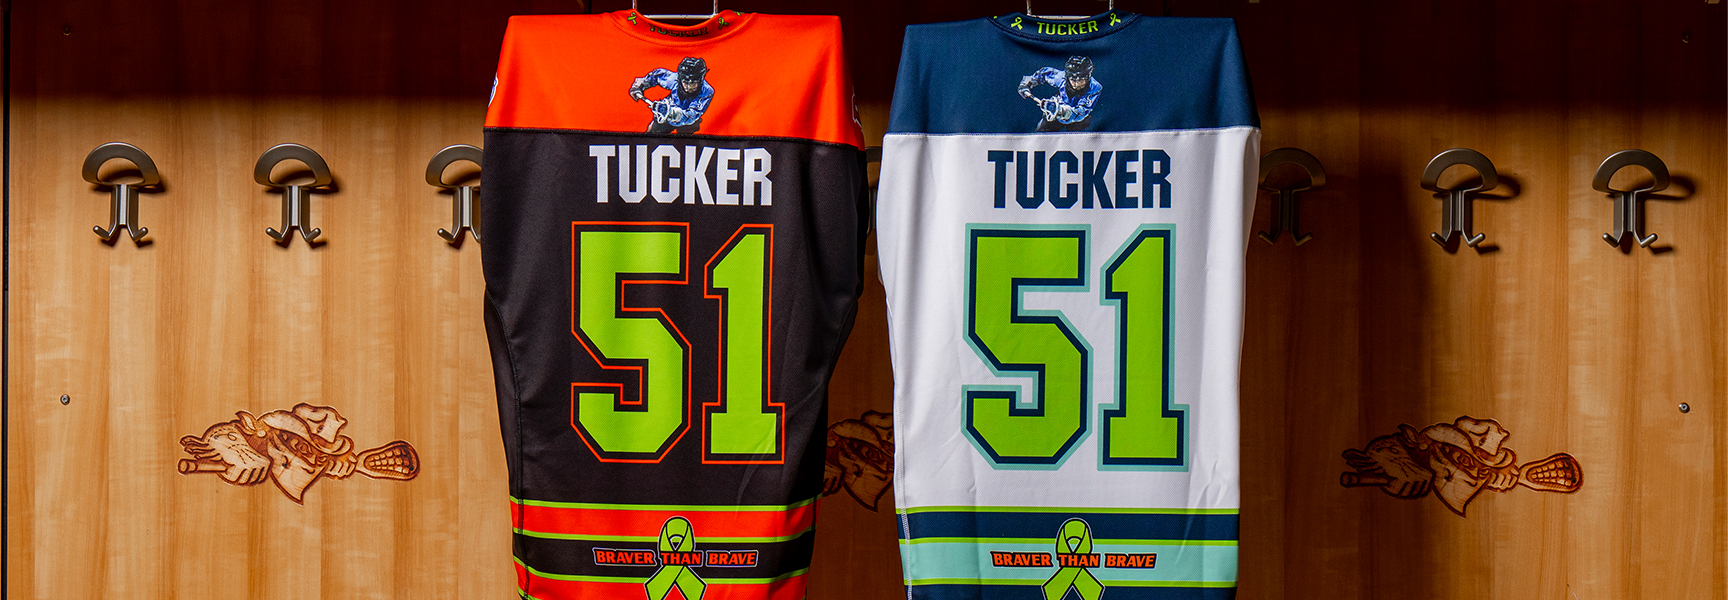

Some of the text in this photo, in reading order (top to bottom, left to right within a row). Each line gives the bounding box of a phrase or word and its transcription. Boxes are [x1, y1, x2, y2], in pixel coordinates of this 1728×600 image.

[650, 25, 709, 37] TUCKER
[1036, 20, 1099, 36] TUCKER
[589, 144, 773, 206] TUCKER
[987, 149, 1172, 209] TUCKER
[571, 221, 785, 464] 51
[961, 223, 1190, 472] 51
[596, 550, 756, 565] BRAVER THAN BRAVE
[993, 552, 1155, 567] BRAVER THAN BRAVE
